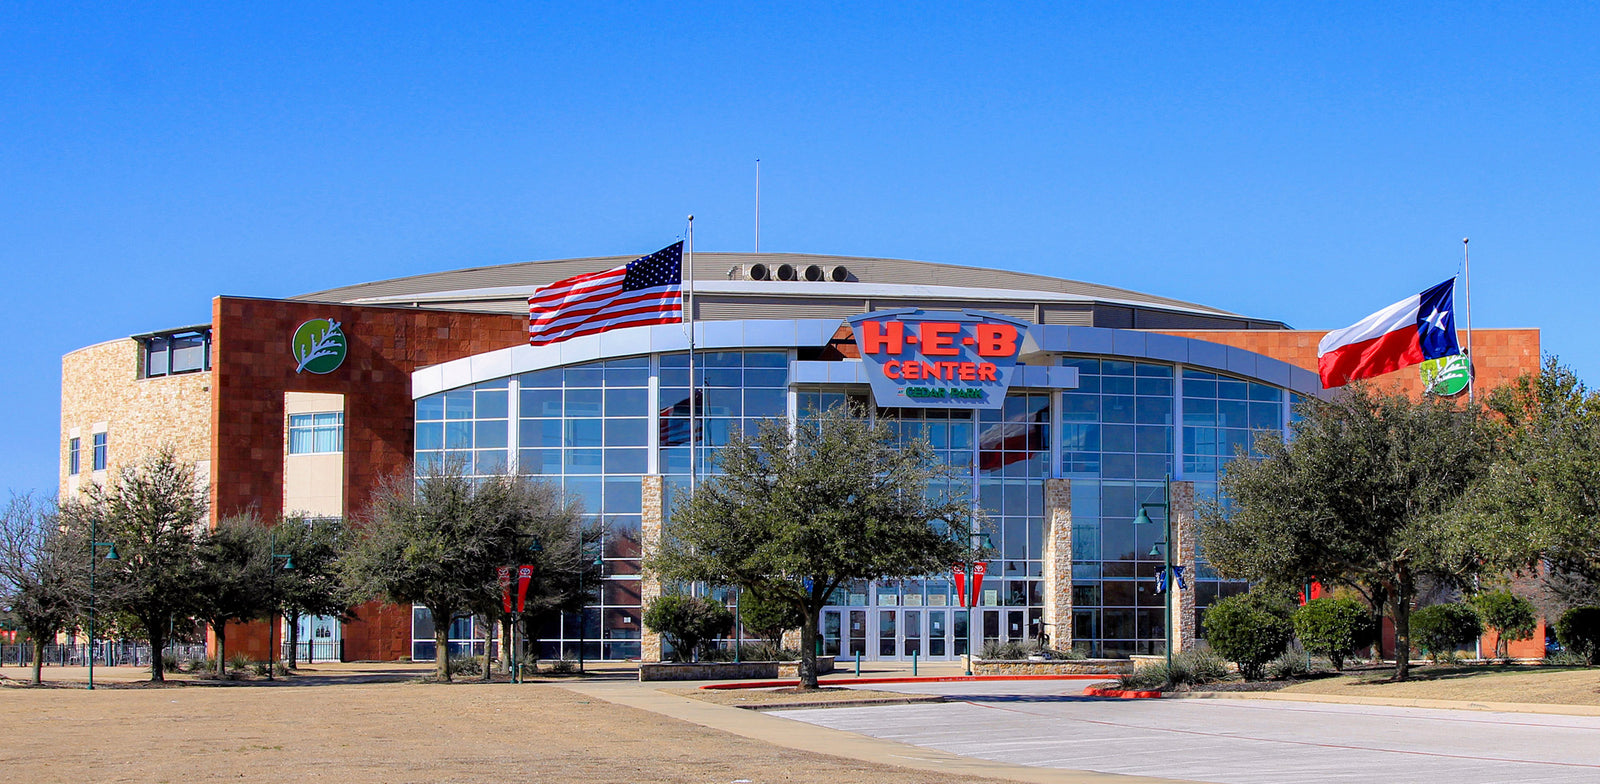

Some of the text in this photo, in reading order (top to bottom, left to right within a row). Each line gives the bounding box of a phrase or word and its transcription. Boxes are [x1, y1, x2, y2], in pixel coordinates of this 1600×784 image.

[862, 321, 1018, 357] H-E-B
[883, 360, 997, 381] CENTER
[905, 387, 946, 398] CEDAR
[950, 387, 983, 399] PARK
